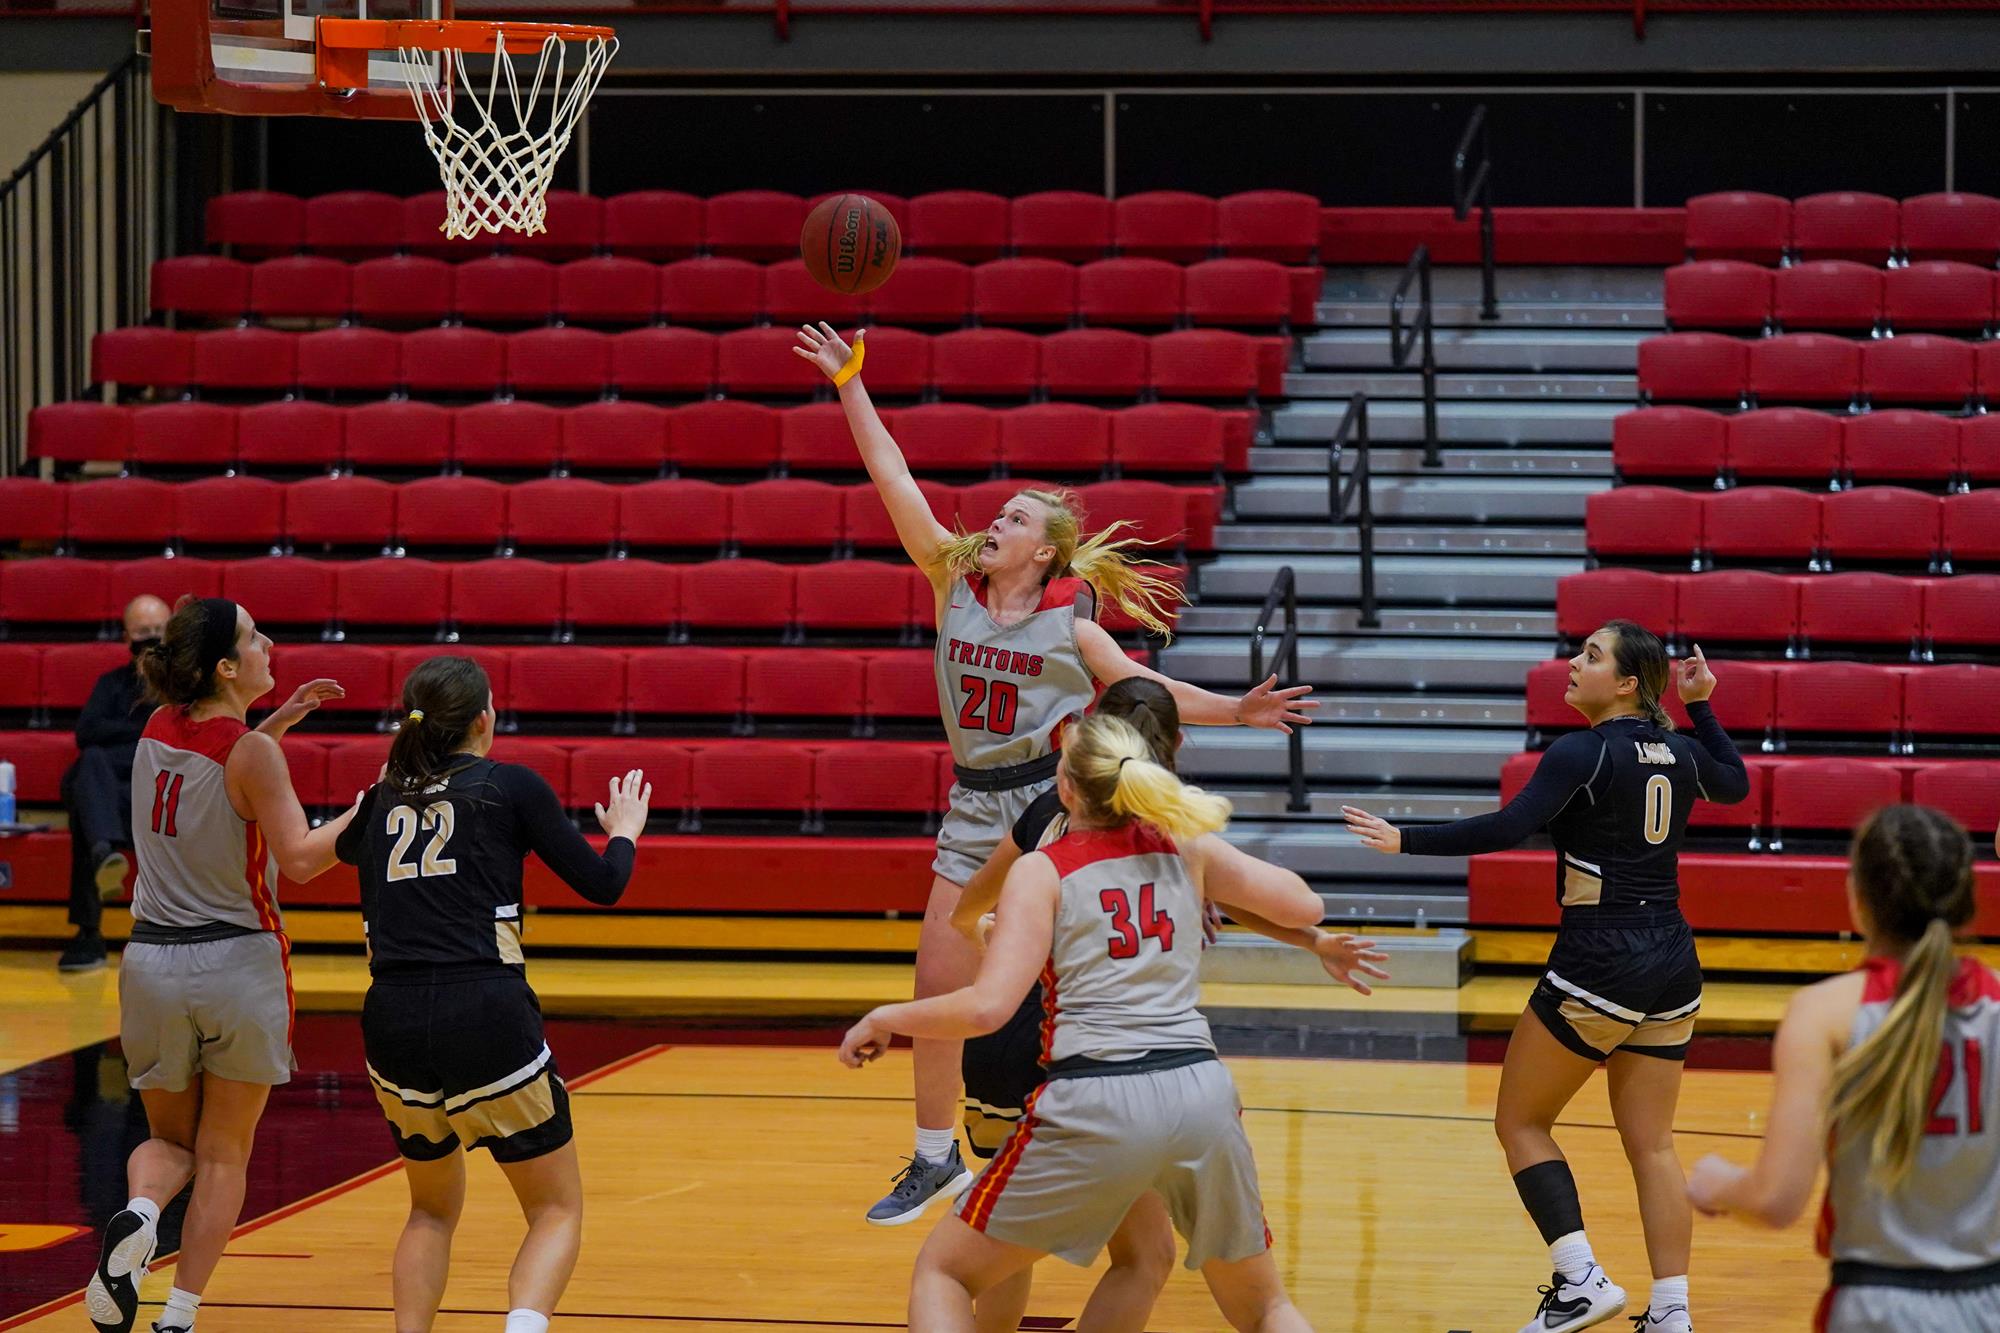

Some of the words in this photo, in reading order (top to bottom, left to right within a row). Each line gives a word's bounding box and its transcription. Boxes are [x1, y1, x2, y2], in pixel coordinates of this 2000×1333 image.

[836, 207, 861, 273] Wilson
[948, 638, 1044, 677] TRITONS
[958, 674, 1019, 736] 20
[151, 769, 184, 838] 11
[1644, 774, 1673, 845] 0
[386, 800, 457, 883] 22
[1099, 882, 1175, 960] 34
[1923, 1037, 1985, 1137] 21
